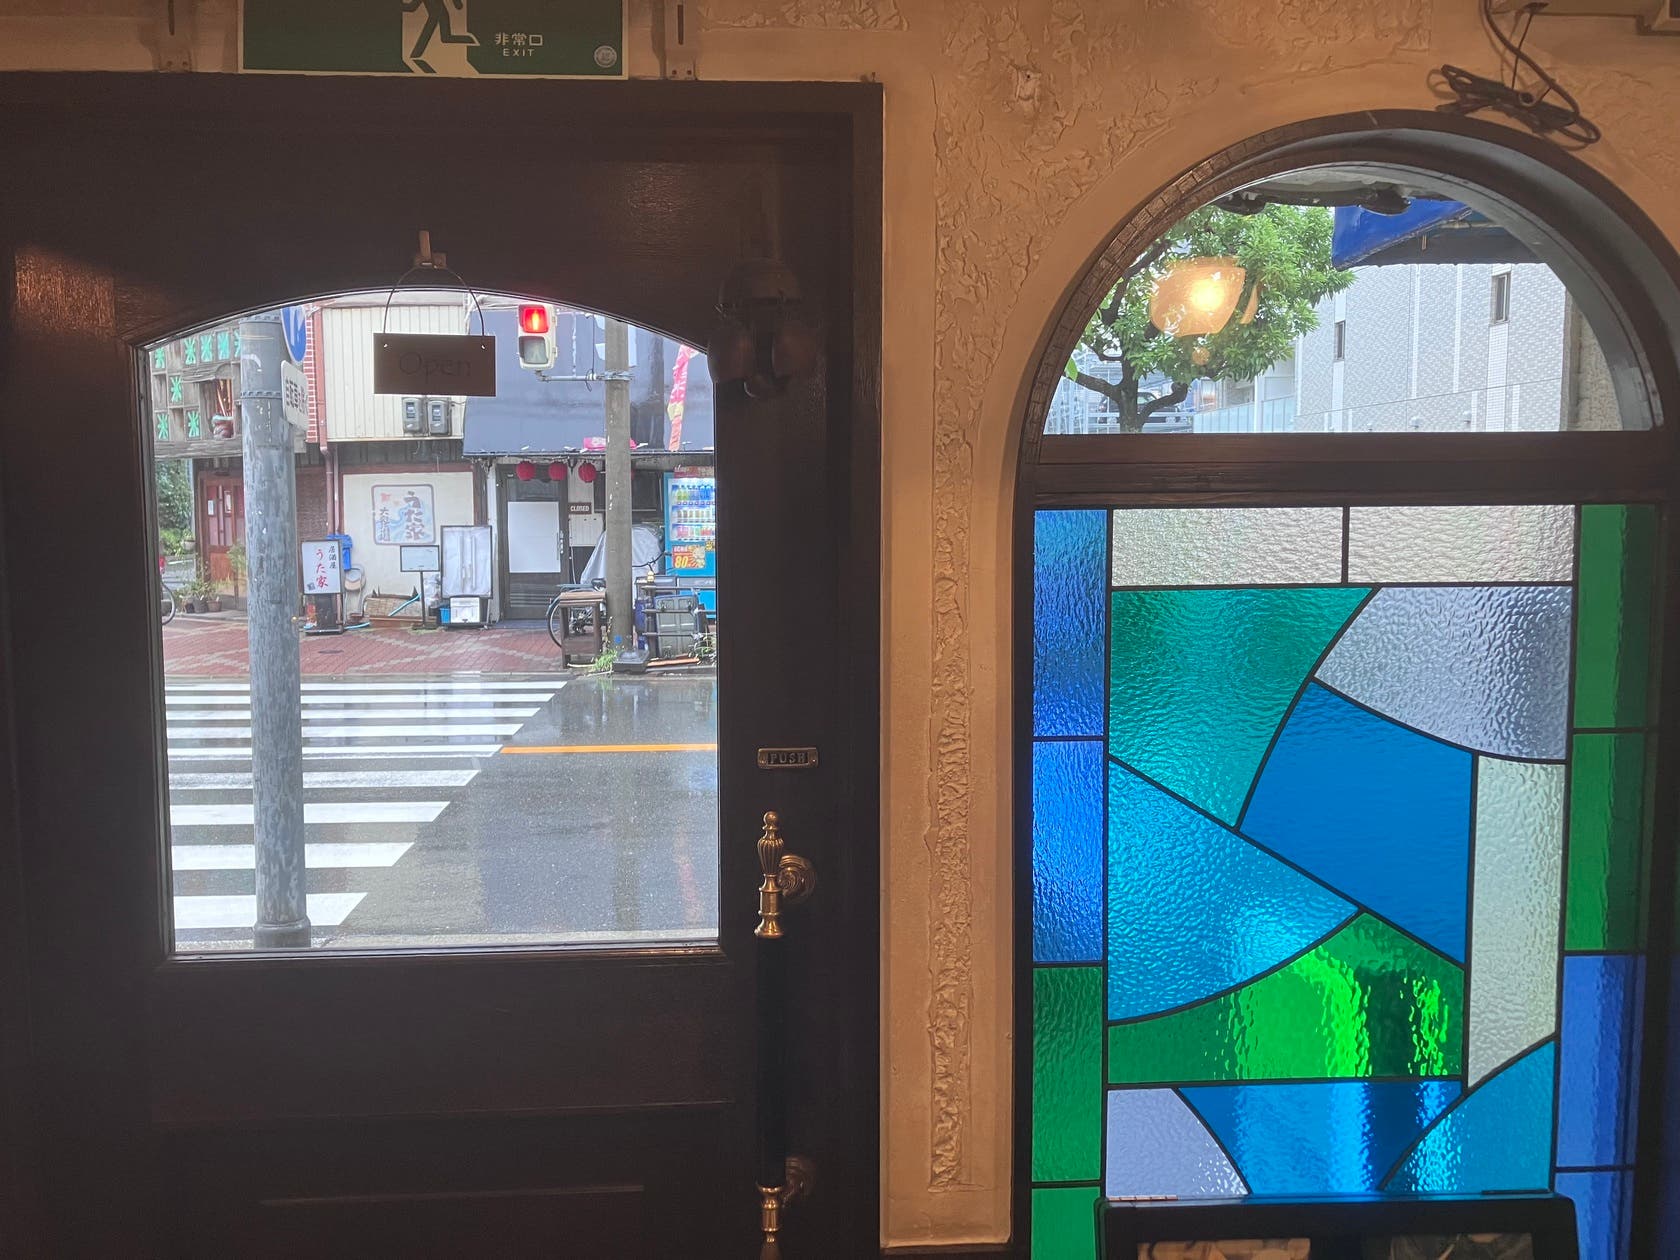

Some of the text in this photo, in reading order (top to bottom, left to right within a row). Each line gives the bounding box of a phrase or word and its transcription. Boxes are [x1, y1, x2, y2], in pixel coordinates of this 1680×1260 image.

[495, 32, 543, 46] 非常口
[503, 48, 535, 57] EXIT
[400, 351, 472, 384] Open
[403, 490, 425, 541] うた家
[328, 545, 337, 569] 居酒屋
[674, 555, 689, 569] 80
[316, 548, 329, 589] うた家
[769, 752, 806, 764] PUSH
